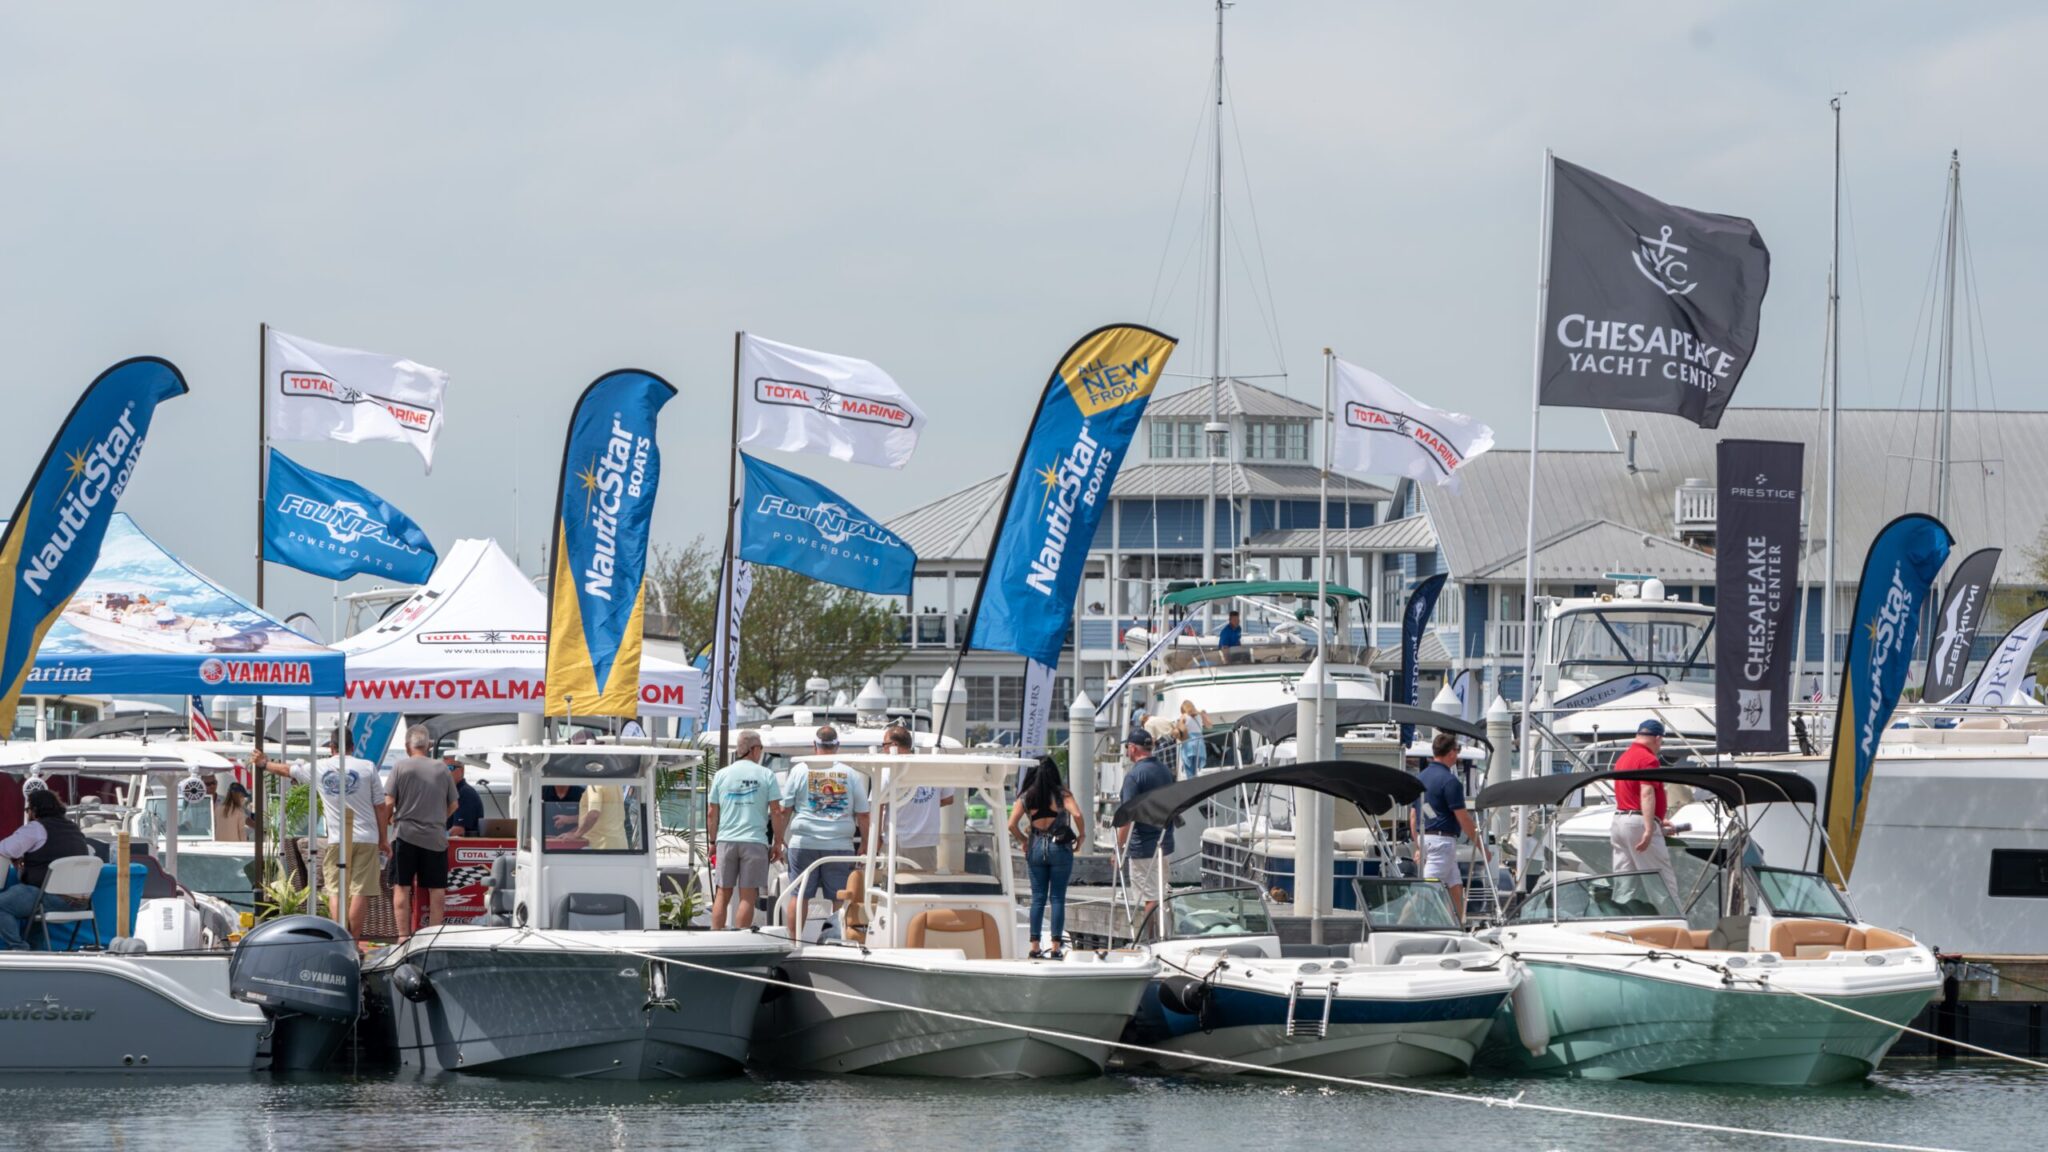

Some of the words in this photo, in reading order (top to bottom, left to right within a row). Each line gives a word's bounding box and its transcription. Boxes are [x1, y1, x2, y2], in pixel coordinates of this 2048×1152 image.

[1078, 357, 1108, 377] ALL
[1556, 313, 1736, 378] CHESAPEAKE
[1568, 353, 1652, 377] YACHT
[1080, 356, 1150, 396] NEW
[1089, 381, 1138, 407] FROM
[387, 405, 427, 425] ARINE
[764, 384, 810, 402] TOTAL
[841, 400, 906, 422] MARINE
[1354, 408, 1391, 425] TOTAL
[1414, 426, 1459, 470] MARINE
[110, 436, 145, 499] BOATS
[628, 436, 650, 499] BOATS
[1082, 446, 1113, 508] BOATS
[23, 408, 136, 596] NauticStar
[585, 421, 634, 600] NauticStar
[1026, 425, 1099, 597] NauticStar
[1731, 487, 1797, 499] PRESTIGE
[288, 531, 394, 571] POWERBOATS
[772, 531, 880, 567] POWERBOATS
[1768, 544, 1782, 612] CENTER
[1744, 534, 1767, 682] CHESAPEAKE
[1763, 618, 1778, 673] YACHT
[1861, 566, 1905, 757] NauticStar
[26, 661, 93, 682] arina
[228, 661, 312, 684] YAMAHA
[1026, 684, 1040, 743] BROKERS
[1567, 688, 1616, 708] BROKERS
[312, 972, 346, 986] YAMAHA
